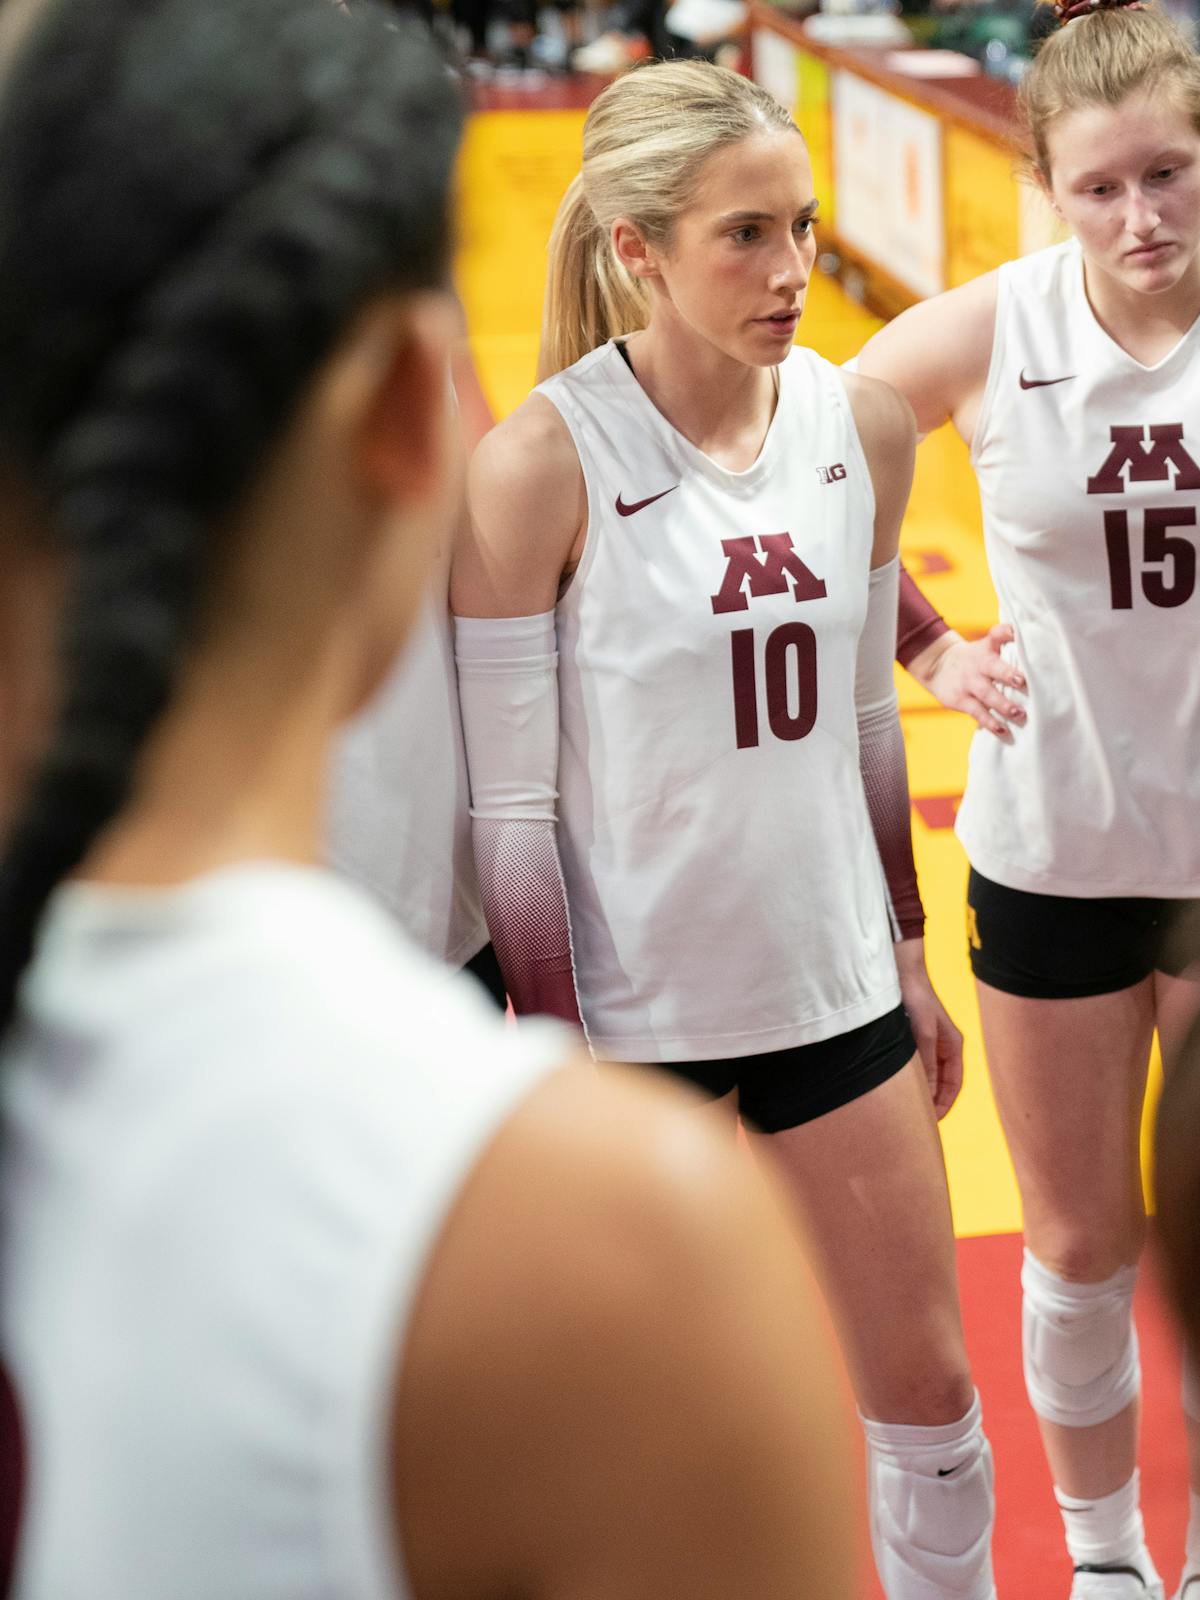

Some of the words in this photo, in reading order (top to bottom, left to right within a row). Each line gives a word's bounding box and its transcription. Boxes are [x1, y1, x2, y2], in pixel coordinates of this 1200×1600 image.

[711, 534, 827, 614] M
[1104, 507, 1196, 609] 15
[732, 622, 817, 749] 10
